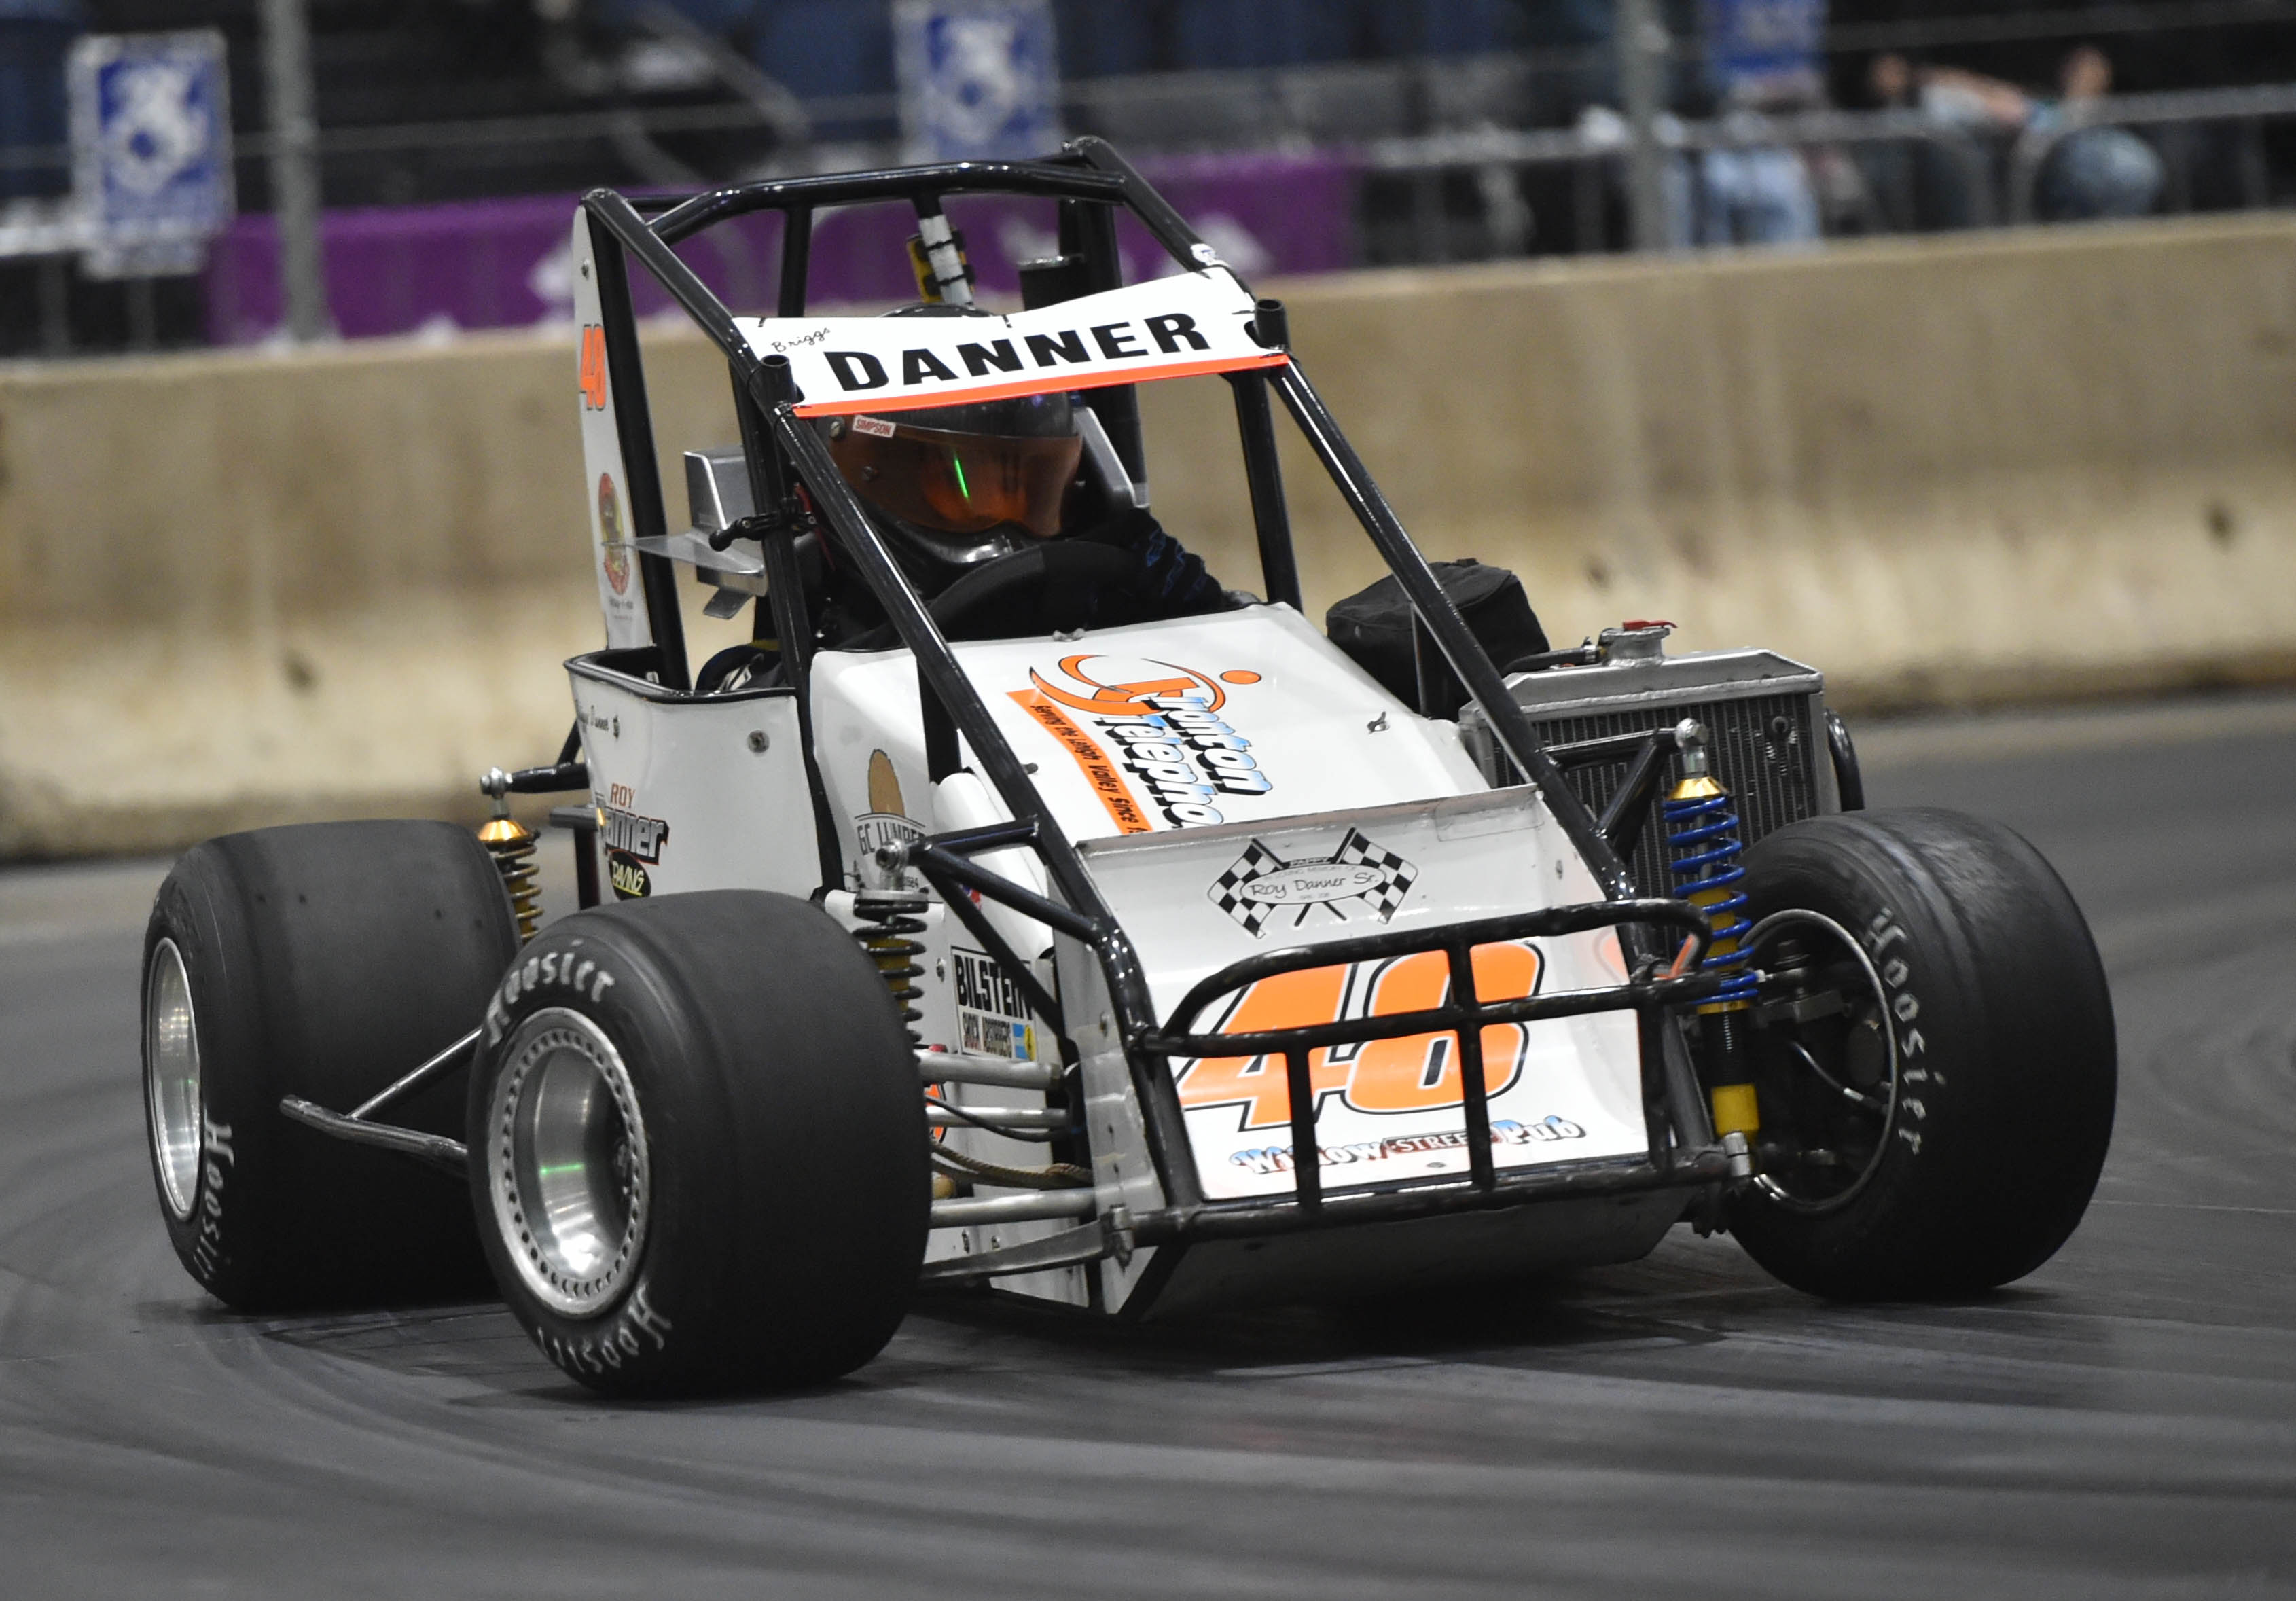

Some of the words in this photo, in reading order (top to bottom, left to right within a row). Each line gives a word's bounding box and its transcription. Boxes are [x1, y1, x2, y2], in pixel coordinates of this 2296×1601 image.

[771, 327, 830, 353] Briggs
[823, 312, 1211, 392] DANNER
[855, 418, 893, 436] SIMPSON
[1030, 705, 1066, 725] Serving
[1055, 727, 1079, 736] the
[1141, 696, 1273, 795] Ironton
[1066, 738, 1103, 761] Lehigh
[1088, 765, 1122, 793] Valley
[1093, 715, 1223, 828] Telepho
[611, 782, 636, 808] ROY
[1108, 797, 1140, 823] Since
[857, 823, 876, 856] GC
[611, 860, 645, 893] PAVING
[1249, 884, 1287, 899] Roy
[1293, 877, 1346, 891] Danner
[1176, 940, 1545, 1132] 48
[1863, 907, 1945, 1155] Hoosier
[1396, 1130, 1469, 1153] STREE
[1490, 1115, 1586, 1144] Pub
